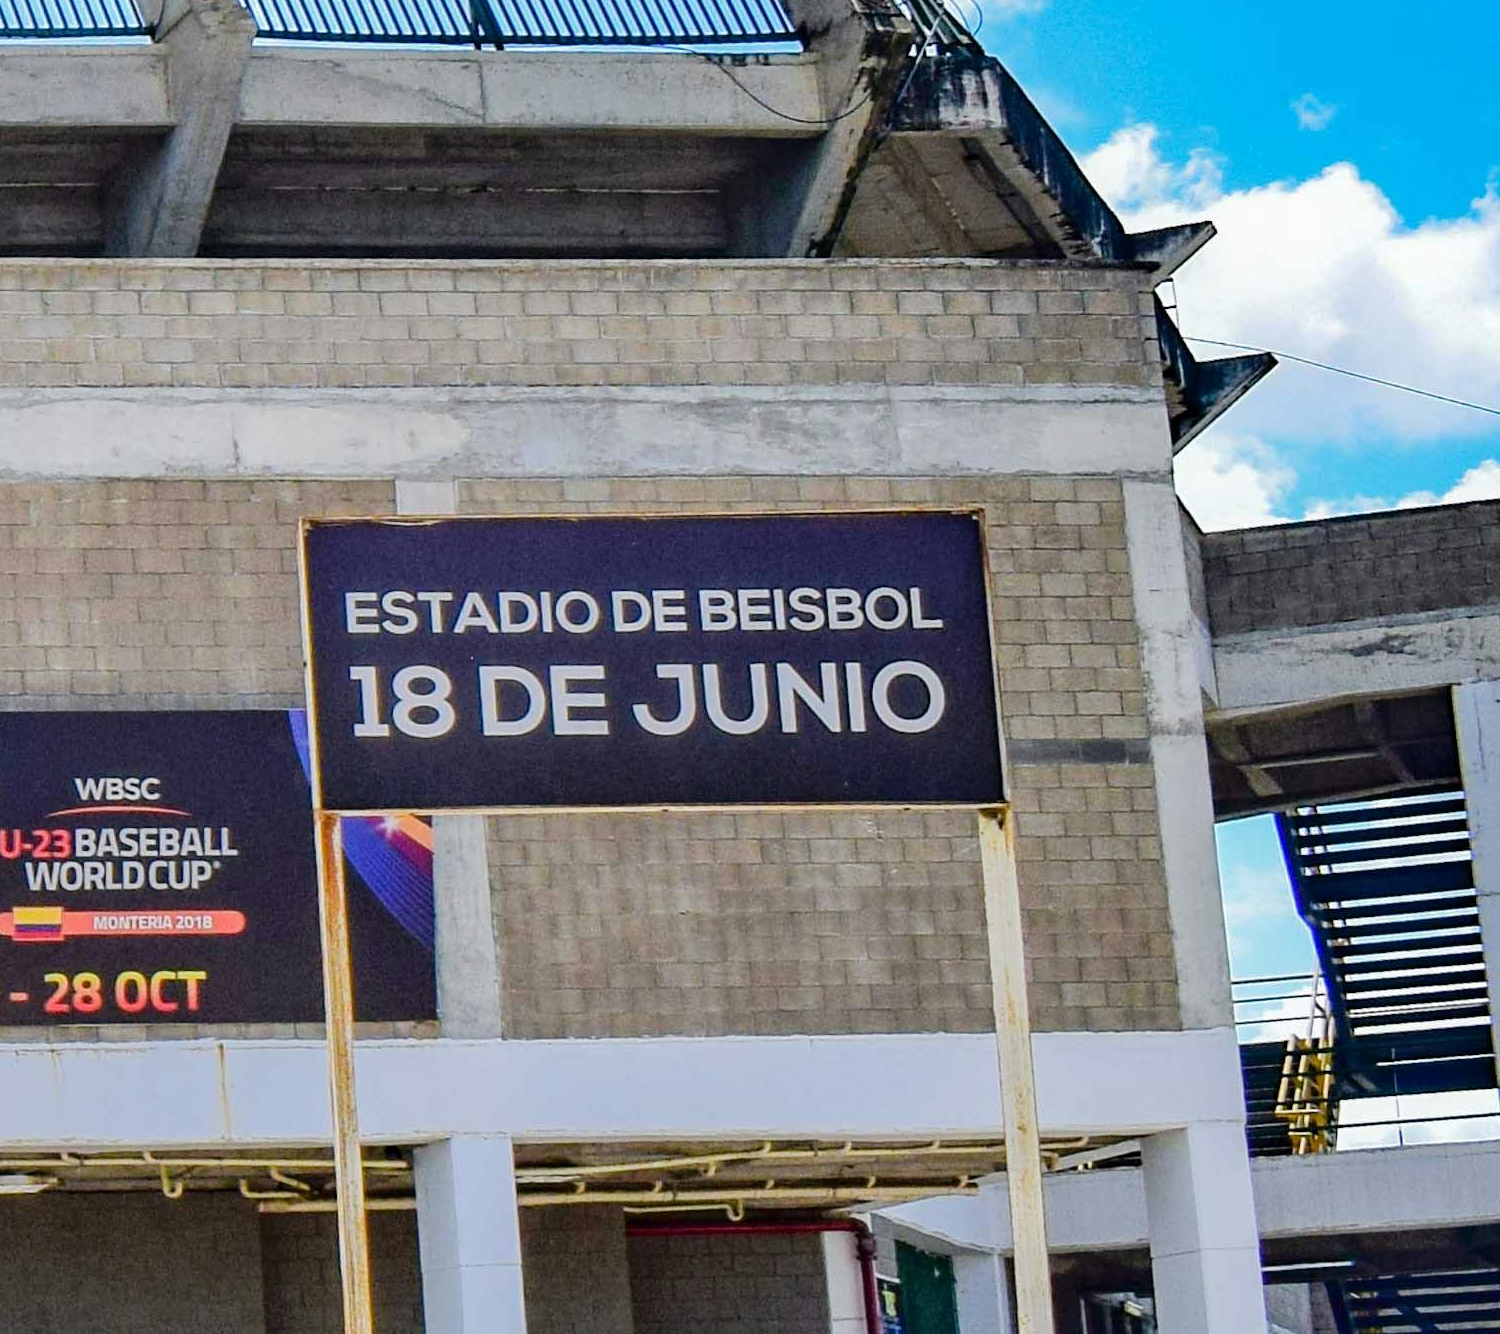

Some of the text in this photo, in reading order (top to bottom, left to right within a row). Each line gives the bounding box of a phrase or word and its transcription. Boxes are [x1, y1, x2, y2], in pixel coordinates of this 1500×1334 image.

[344, 587, 943, 635] ESTADIO DE BEISBOL
[349, 660, 946, 739] 18 DE JUNIO
[74, 777, 161, 801] WBSC
[75, 827, 238, 857] BASEBALL
[25, 861, 212, 891] WORLD CUP
[92, 915, 213, 930] MONTERIA 2018
[9, 992, 29, 1002] -
[44, 972, 103, 1013] 28
[115, 970, 207, 1013] OCT
